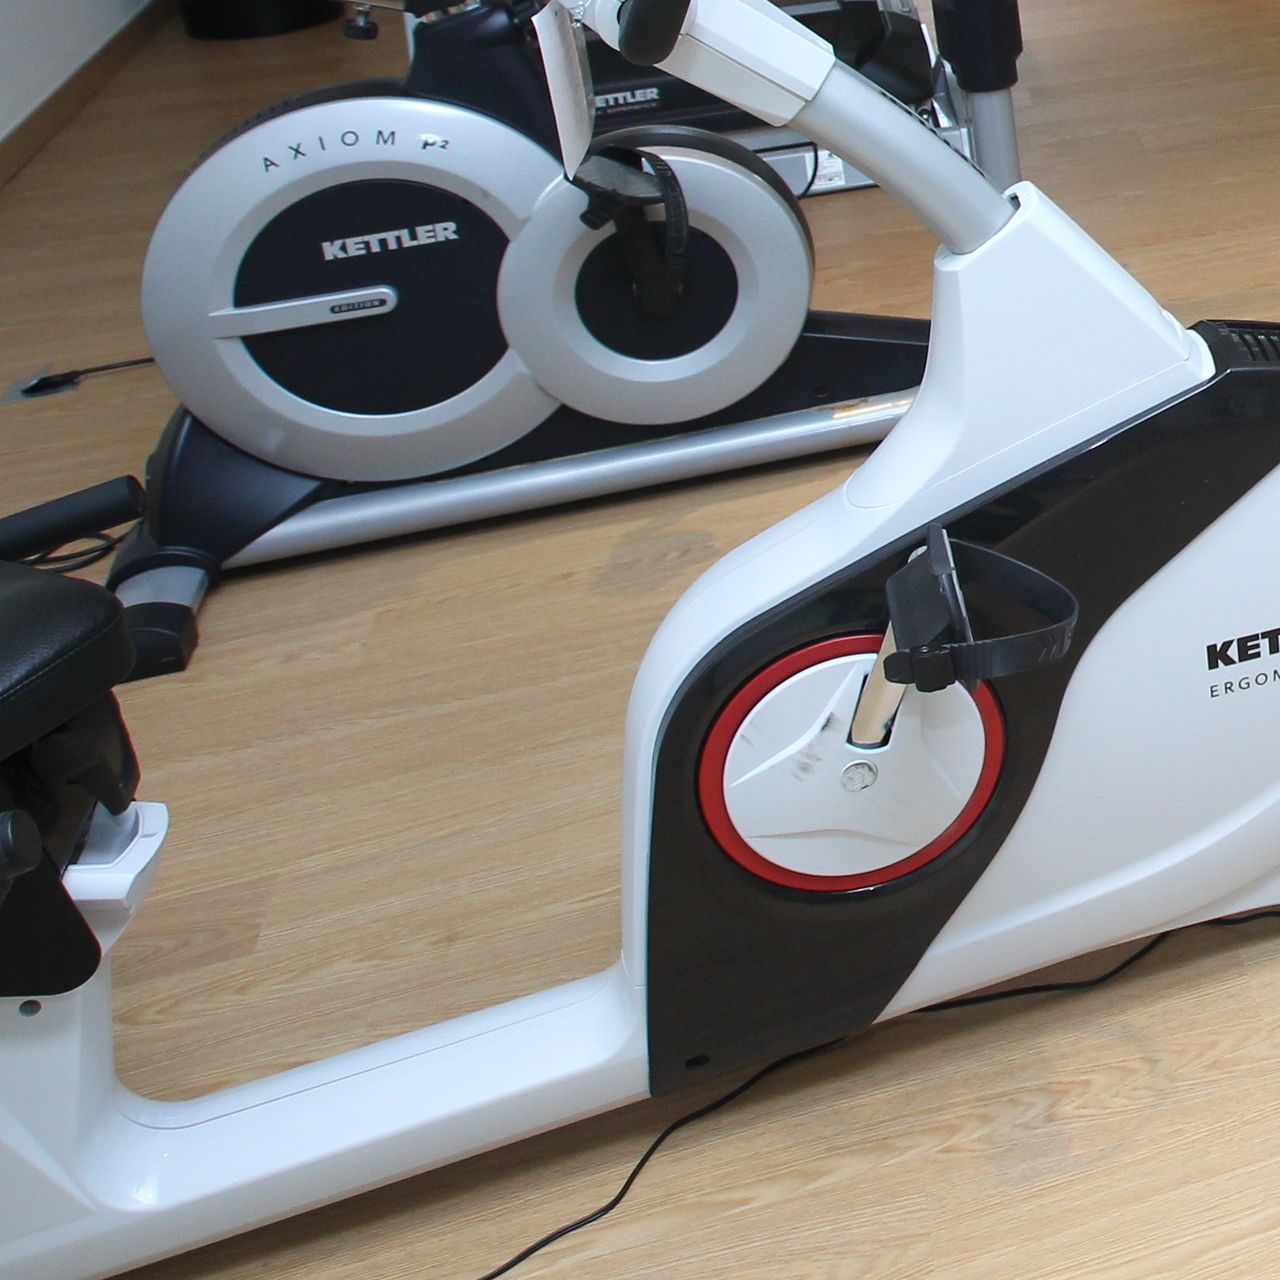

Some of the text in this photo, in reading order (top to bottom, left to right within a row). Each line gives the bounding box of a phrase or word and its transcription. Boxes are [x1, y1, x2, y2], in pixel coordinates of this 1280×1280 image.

[594, 87, 659, 108] ETTLER
[263, 130, 396, 171] AXIOM
[321, 221, 459, 260] KETTLER
